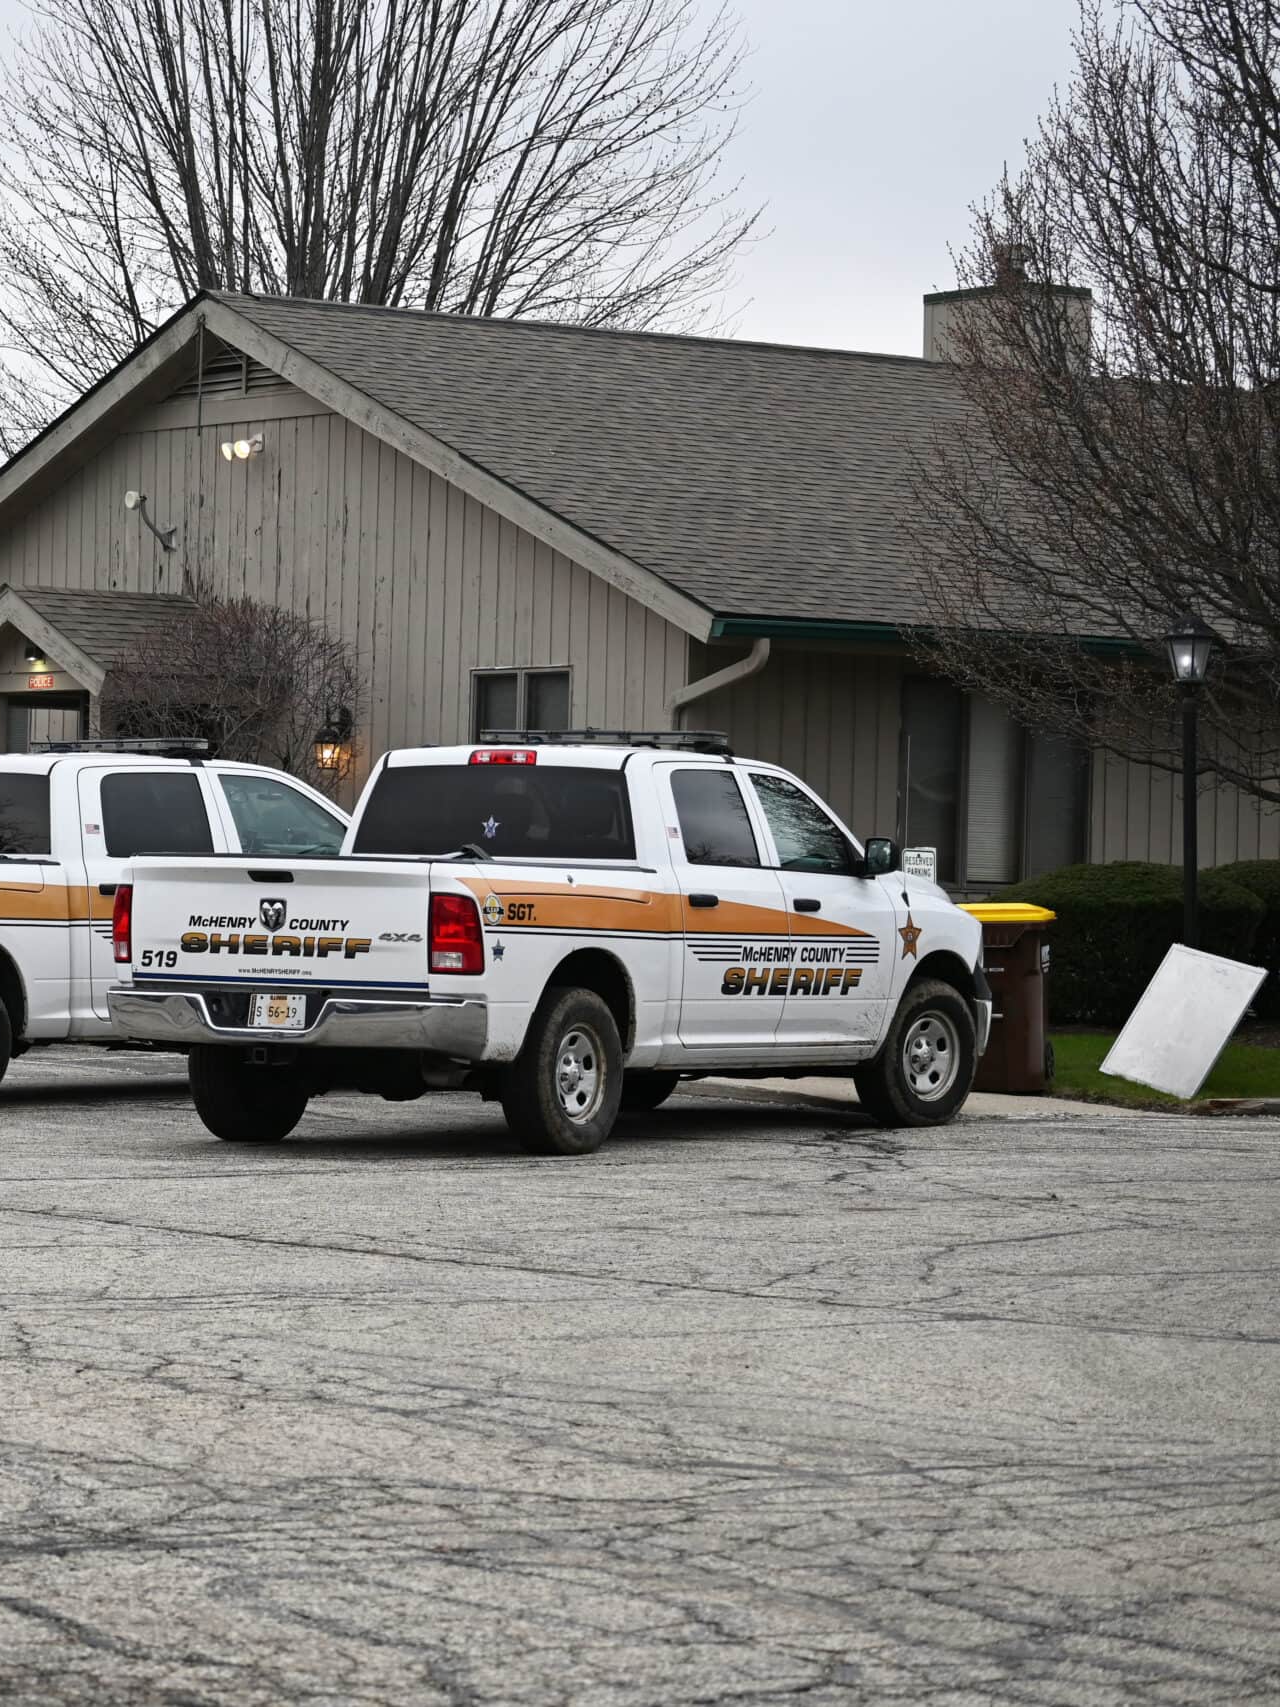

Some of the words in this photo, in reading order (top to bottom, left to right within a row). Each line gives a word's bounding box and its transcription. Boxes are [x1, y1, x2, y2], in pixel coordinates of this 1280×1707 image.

[29, 676, 52, 688] POLICE
[905, 856, 934, 867] RESERVED
[907, 867, 932, 878] PARKING
[507, 903, 537, 921] SGT.
[188, 914, 256, 930] McHENRY
[288, 918, 350, 932] COUNTY
[179, 931, 373, 960] SHERIFF
[141, 949, 178, 969] 519
[741, 946, 797, 963] McHENRY
[800, 947, 846, 963] COUNTY
[720, 966, 863, 997] SHERIFF
[256, 1006, 262, 1018] S
[268, 1006, 297, 1018] 56-19
